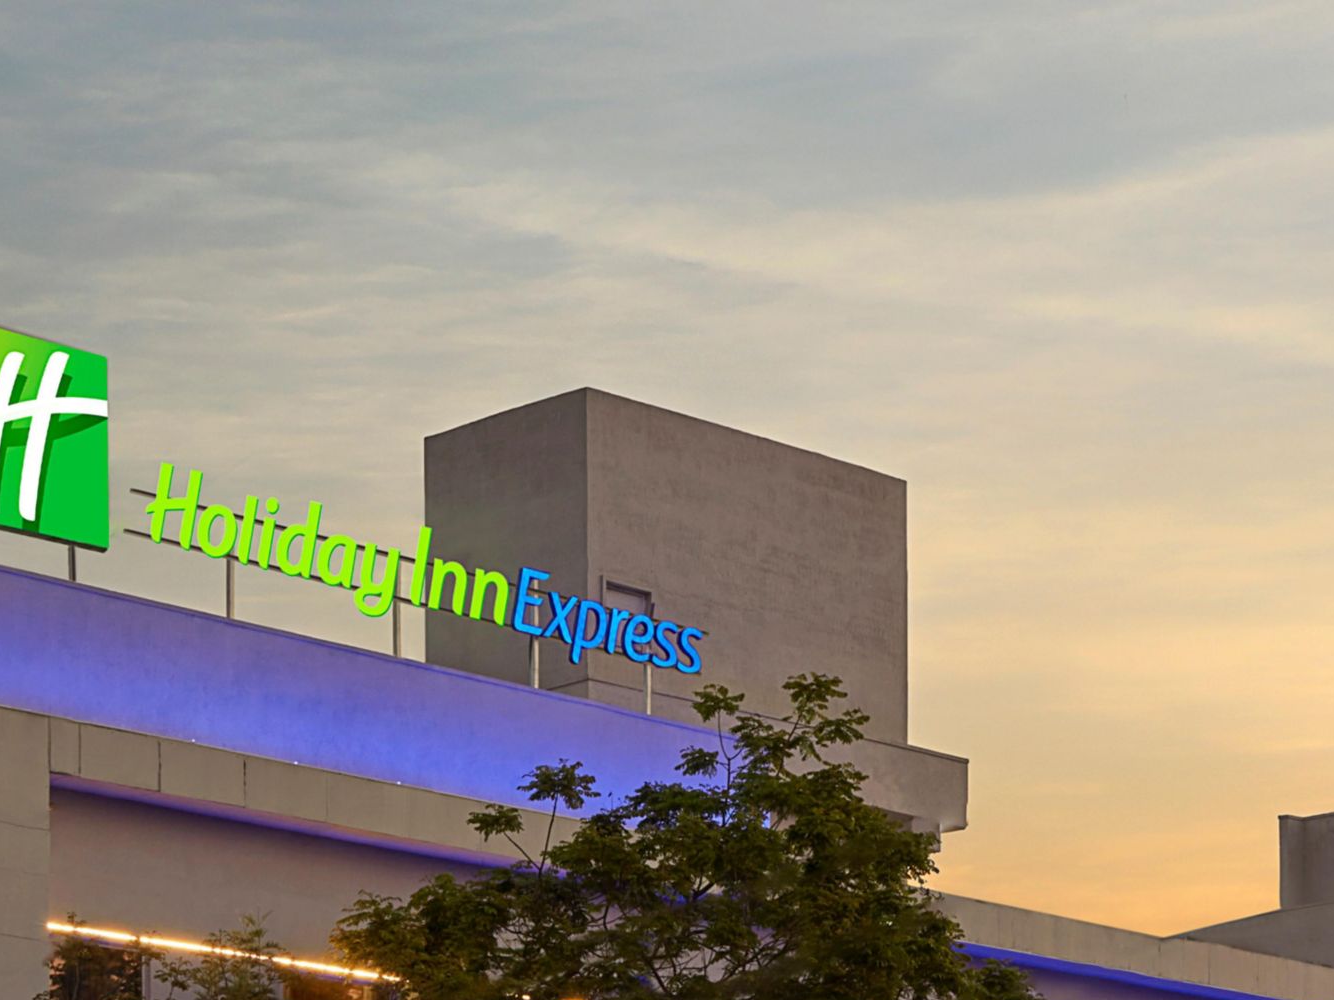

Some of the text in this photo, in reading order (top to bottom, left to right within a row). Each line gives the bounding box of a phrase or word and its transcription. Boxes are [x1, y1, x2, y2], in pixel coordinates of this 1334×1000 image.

[144, 462, 704, 675] Holiday Inn Express
